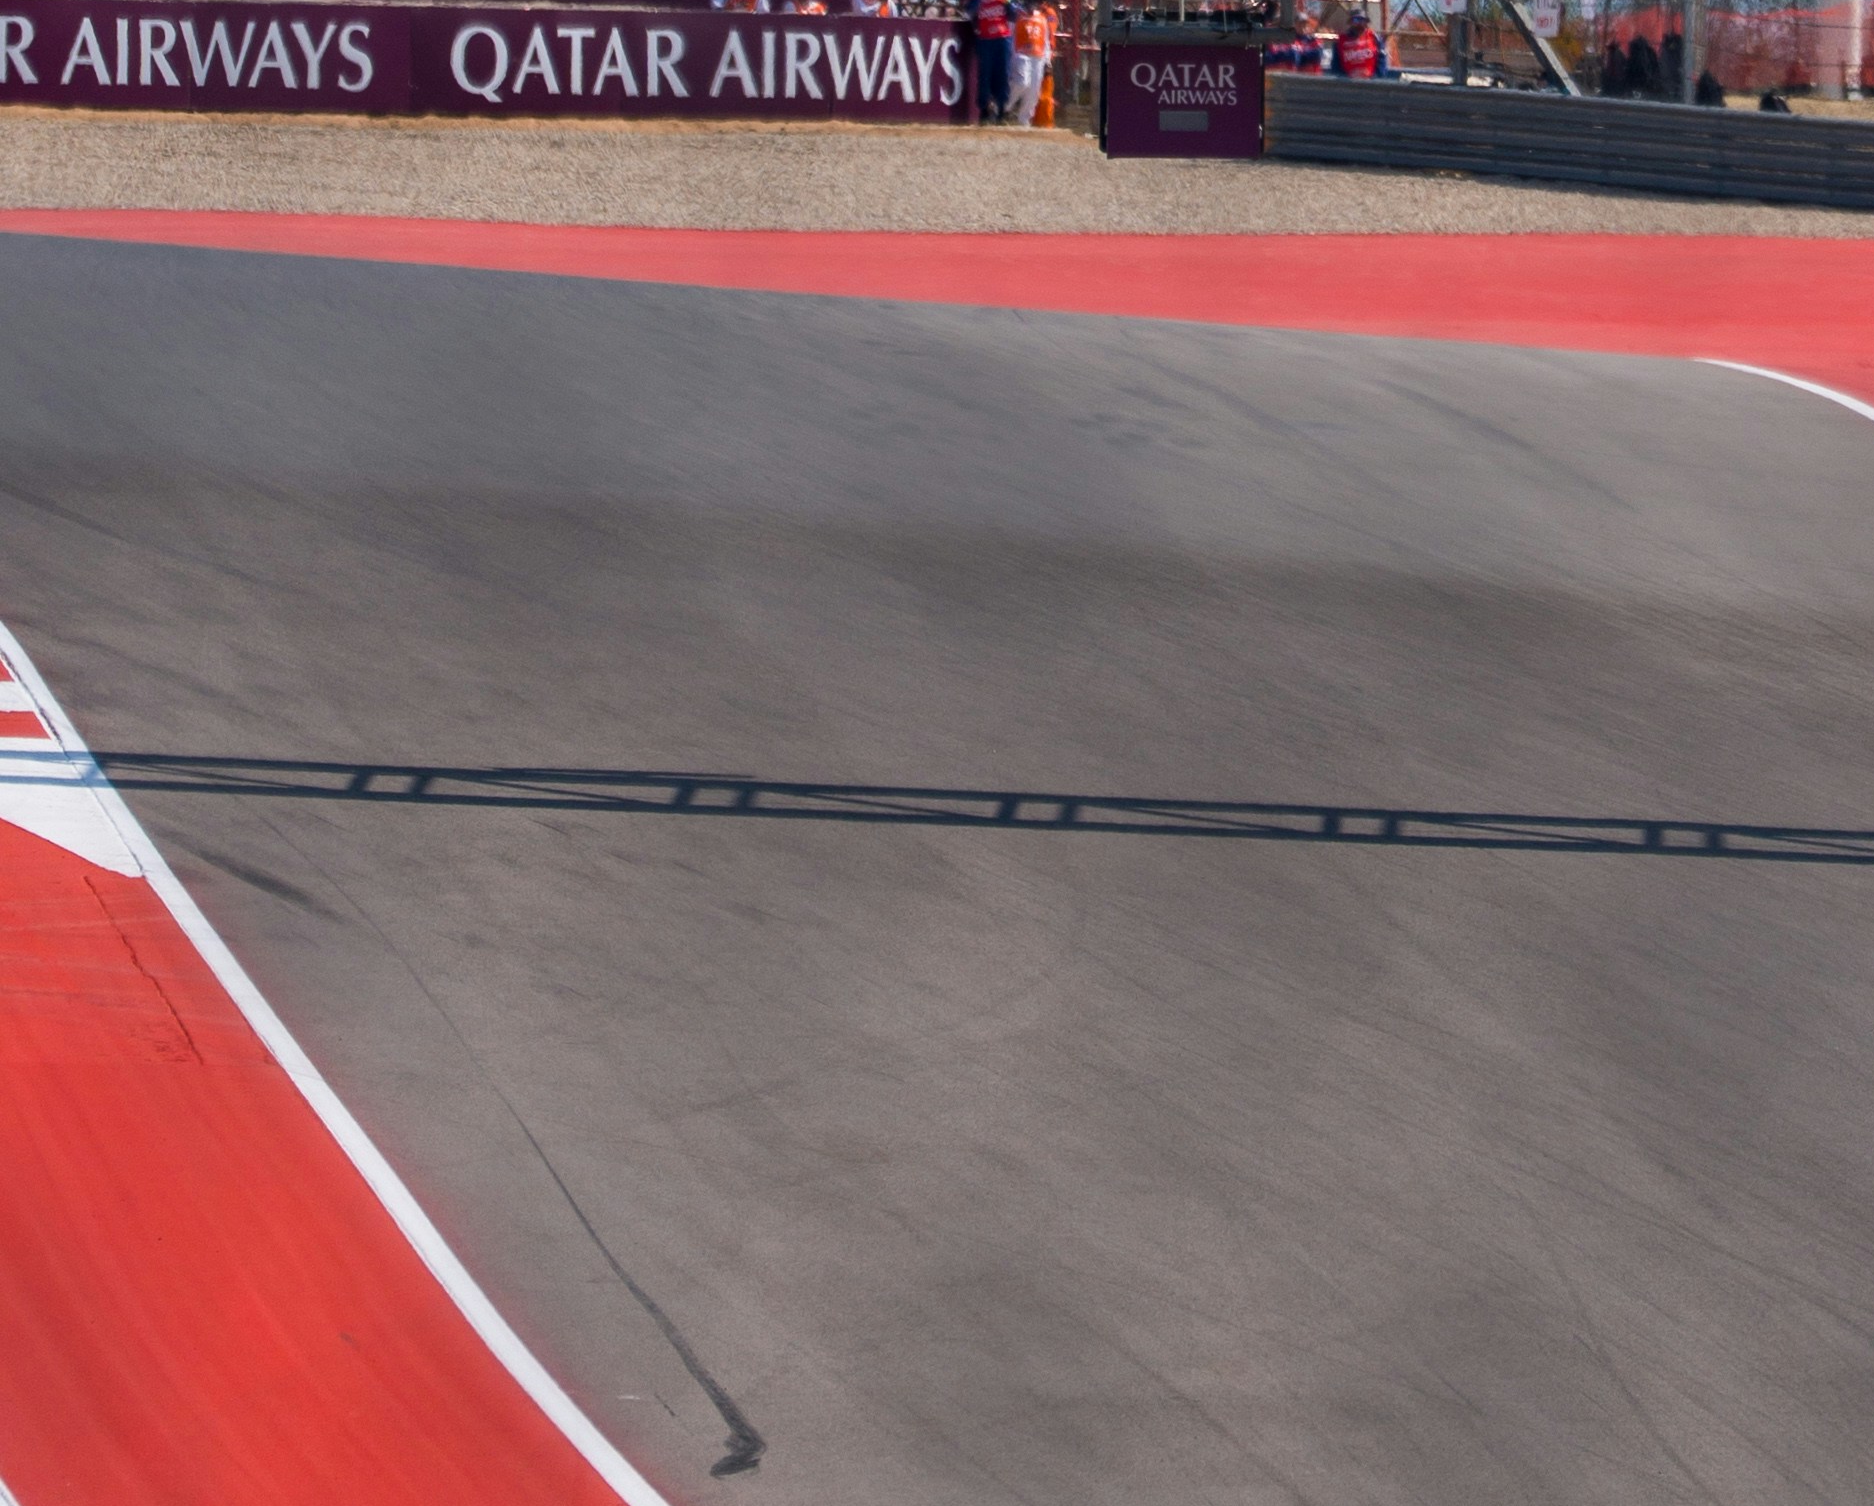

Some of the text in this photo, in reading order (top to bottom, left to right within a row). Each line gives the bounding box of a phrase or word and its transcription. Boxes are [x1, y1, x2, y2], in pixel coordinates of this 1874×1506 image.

[60, 16, 373, 92] AIRWAYS
[450, 25, 963, 106] QATAR AIRWAYS
[1130, 62, 1237, 93] QATAR
[1157, 89, 1238, 106] AIRWAYS
